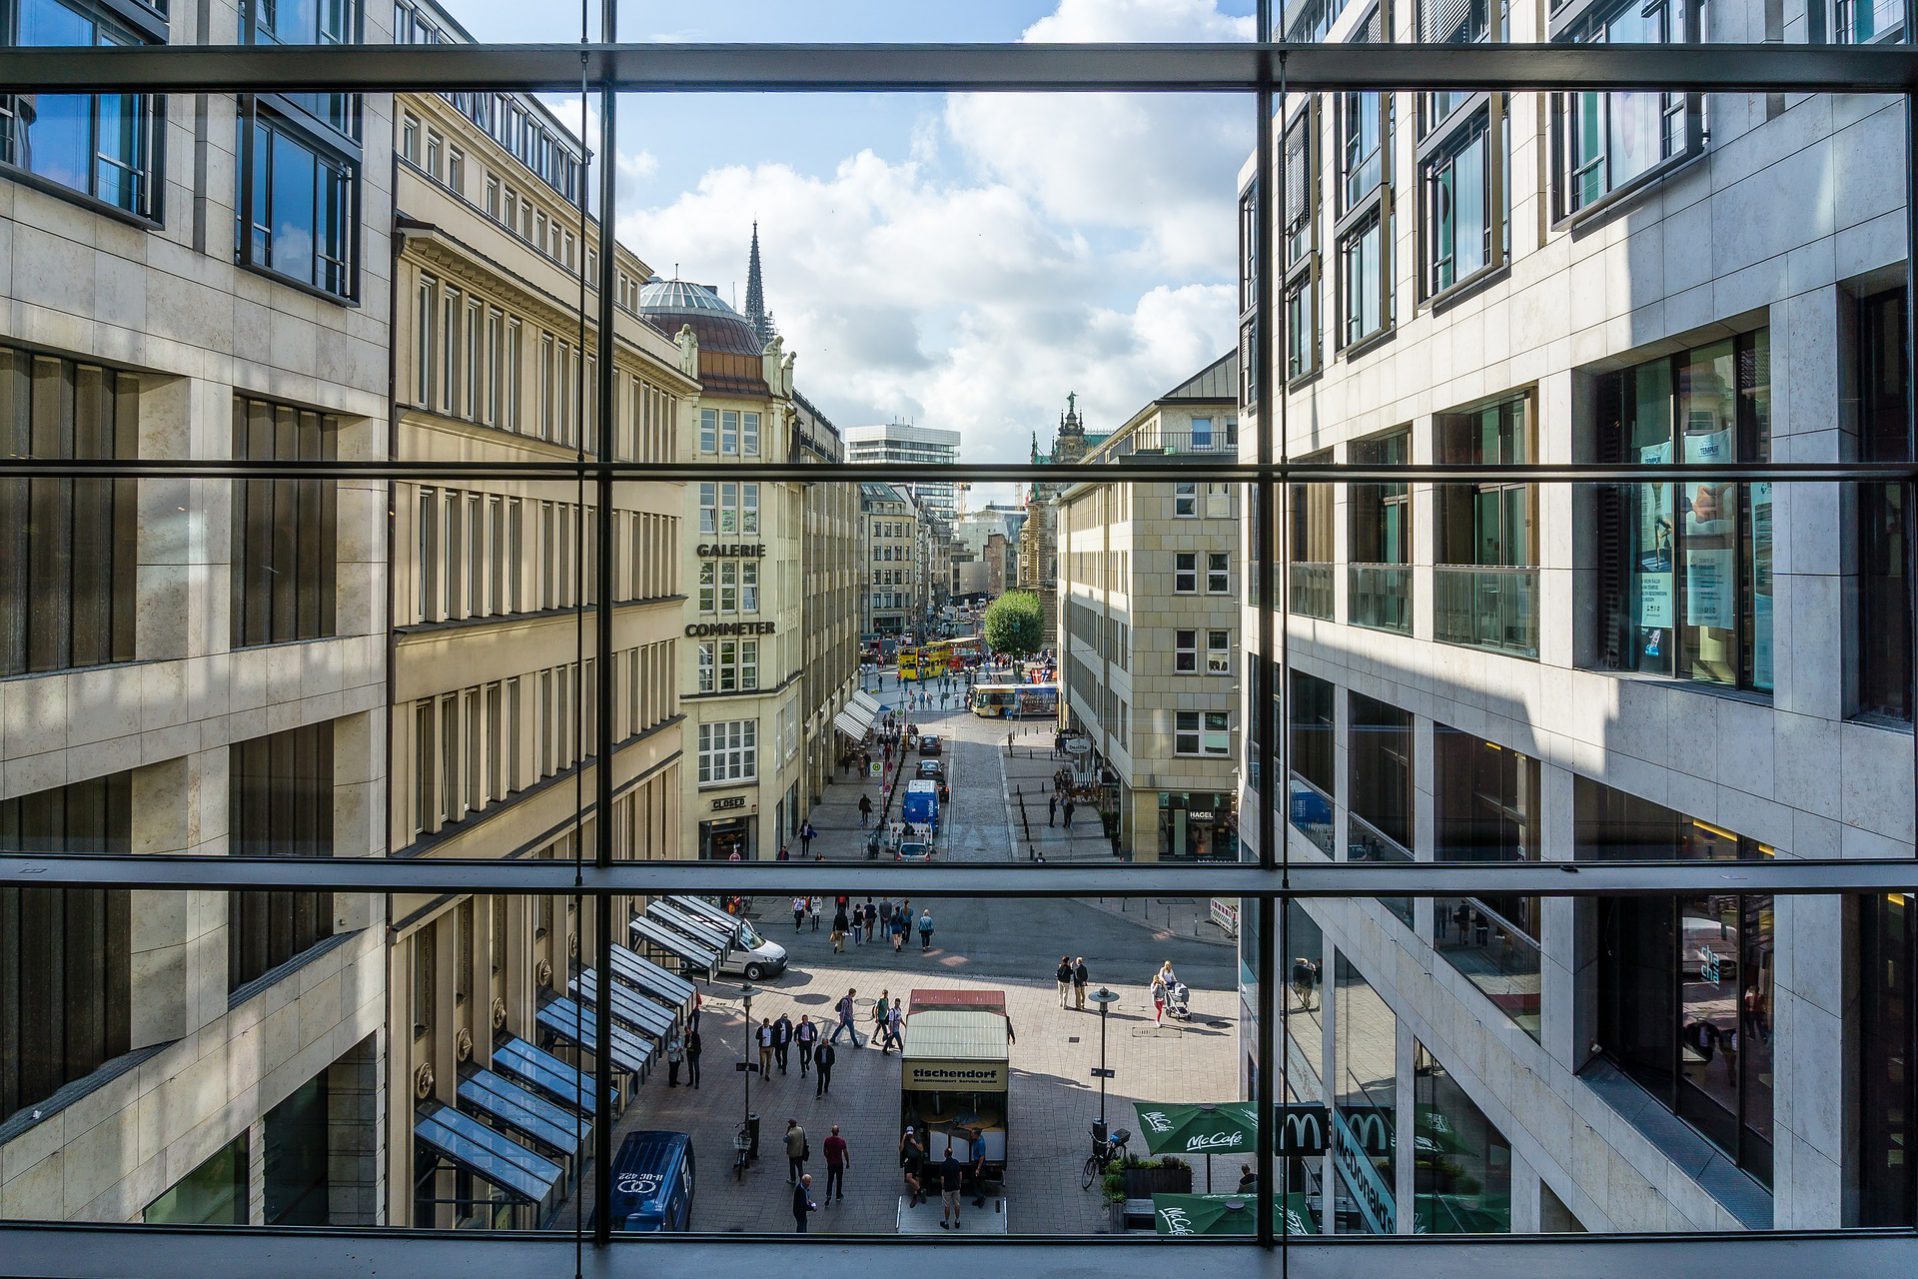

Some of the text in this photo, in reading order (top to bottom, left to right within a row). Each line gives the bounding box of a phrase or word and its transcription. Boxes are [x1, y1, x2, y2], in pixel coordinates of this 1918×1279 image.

[697, 544, 766, 558] GALERIE
[685, 621, 776, 637] COMMETER
[713, 797, 745, 809] CLOSED
[913, 1069, 997, 1078] tischendorf
[1187, 1131, 1243, 1151] McCafé
